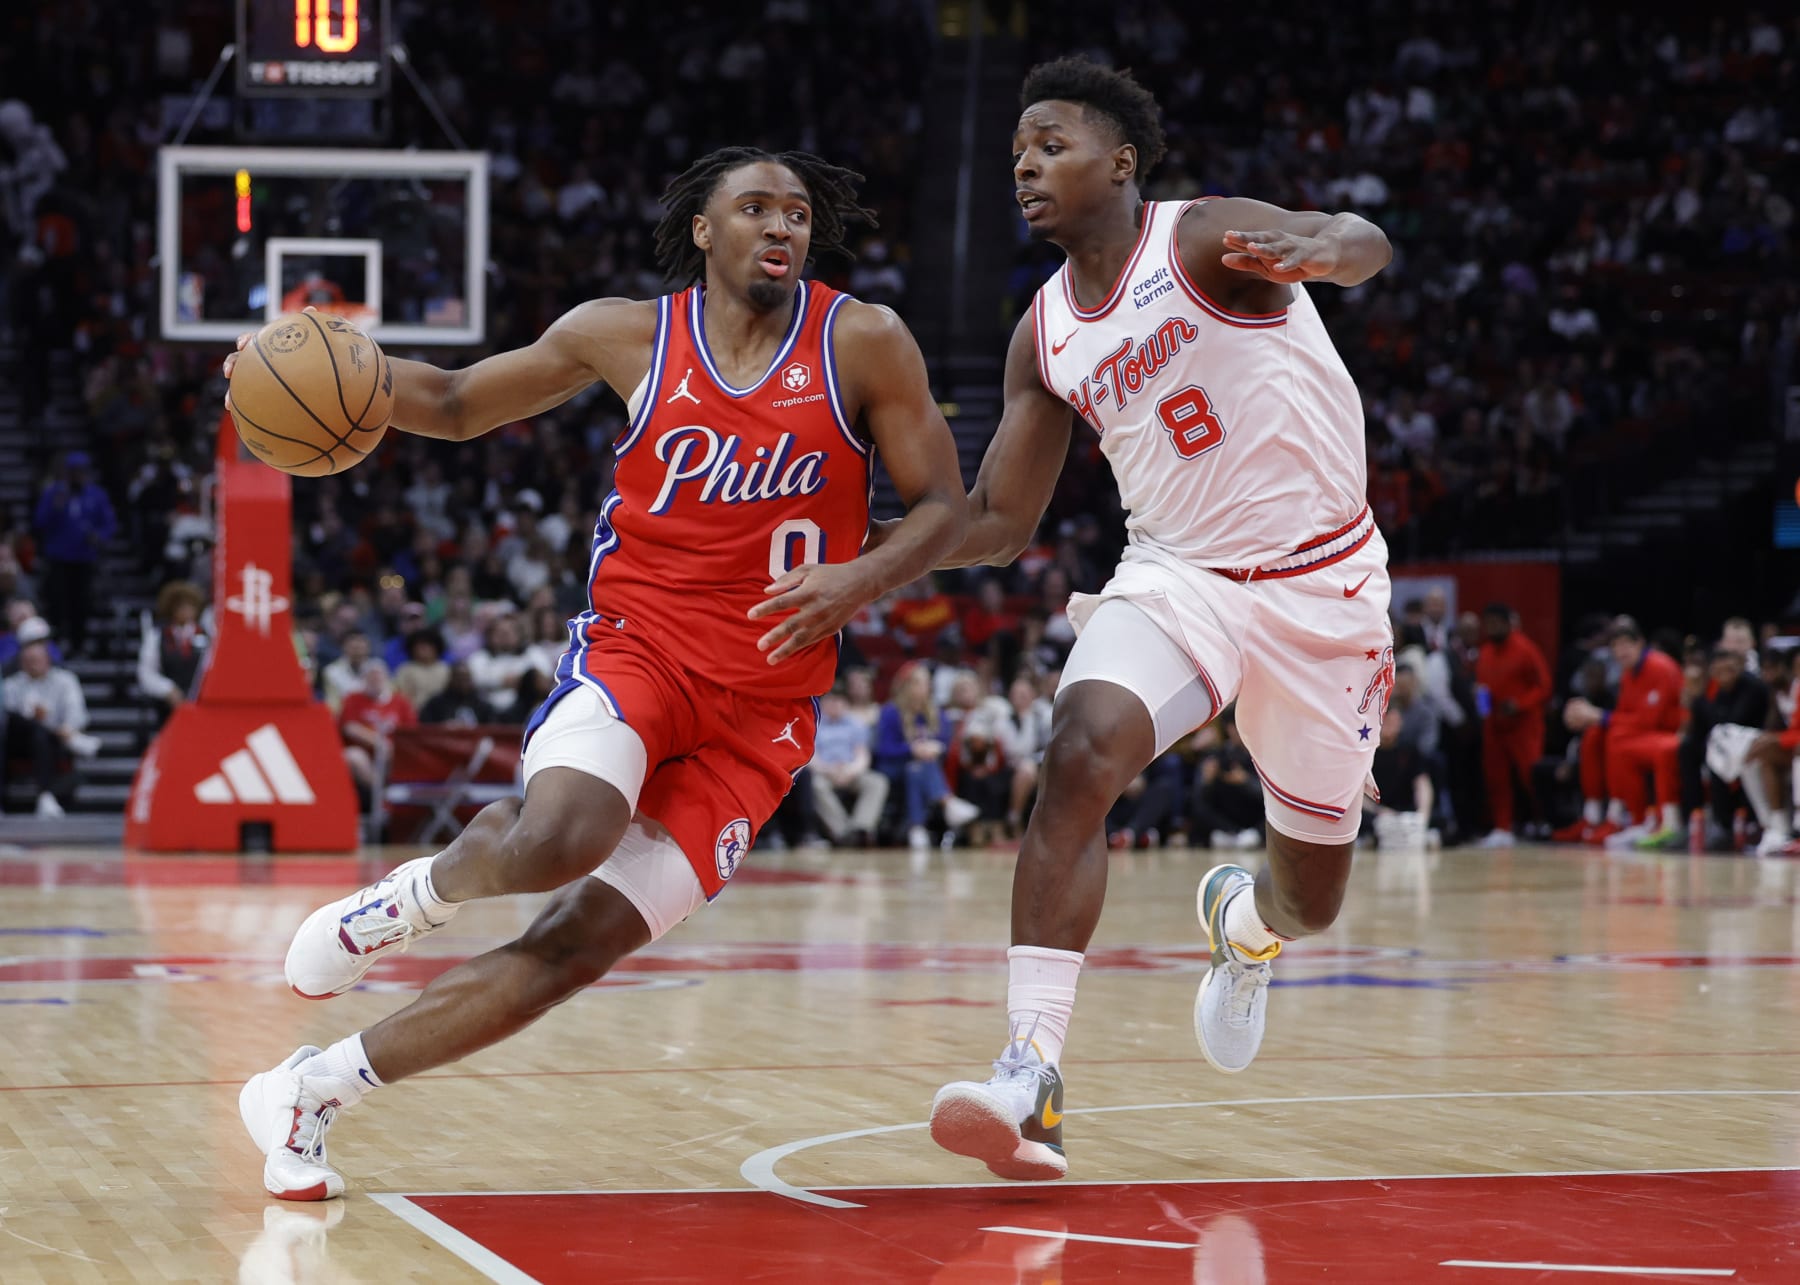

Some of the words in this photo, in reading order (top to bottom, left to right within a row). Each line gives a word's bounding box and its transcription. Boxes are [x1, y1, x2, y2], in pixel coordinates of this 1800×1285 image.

[285, 61, 380, 85] TISSOT
[1133, 267, 1168, 296] credit
[1133, 281, 1175, 310] karma
[772, 393, 825, 408] crypto.com
[1155, 384, 1227, 461] 8
[648, 425, 829, 516] Phila
[769, 518, 827, 584] 0
